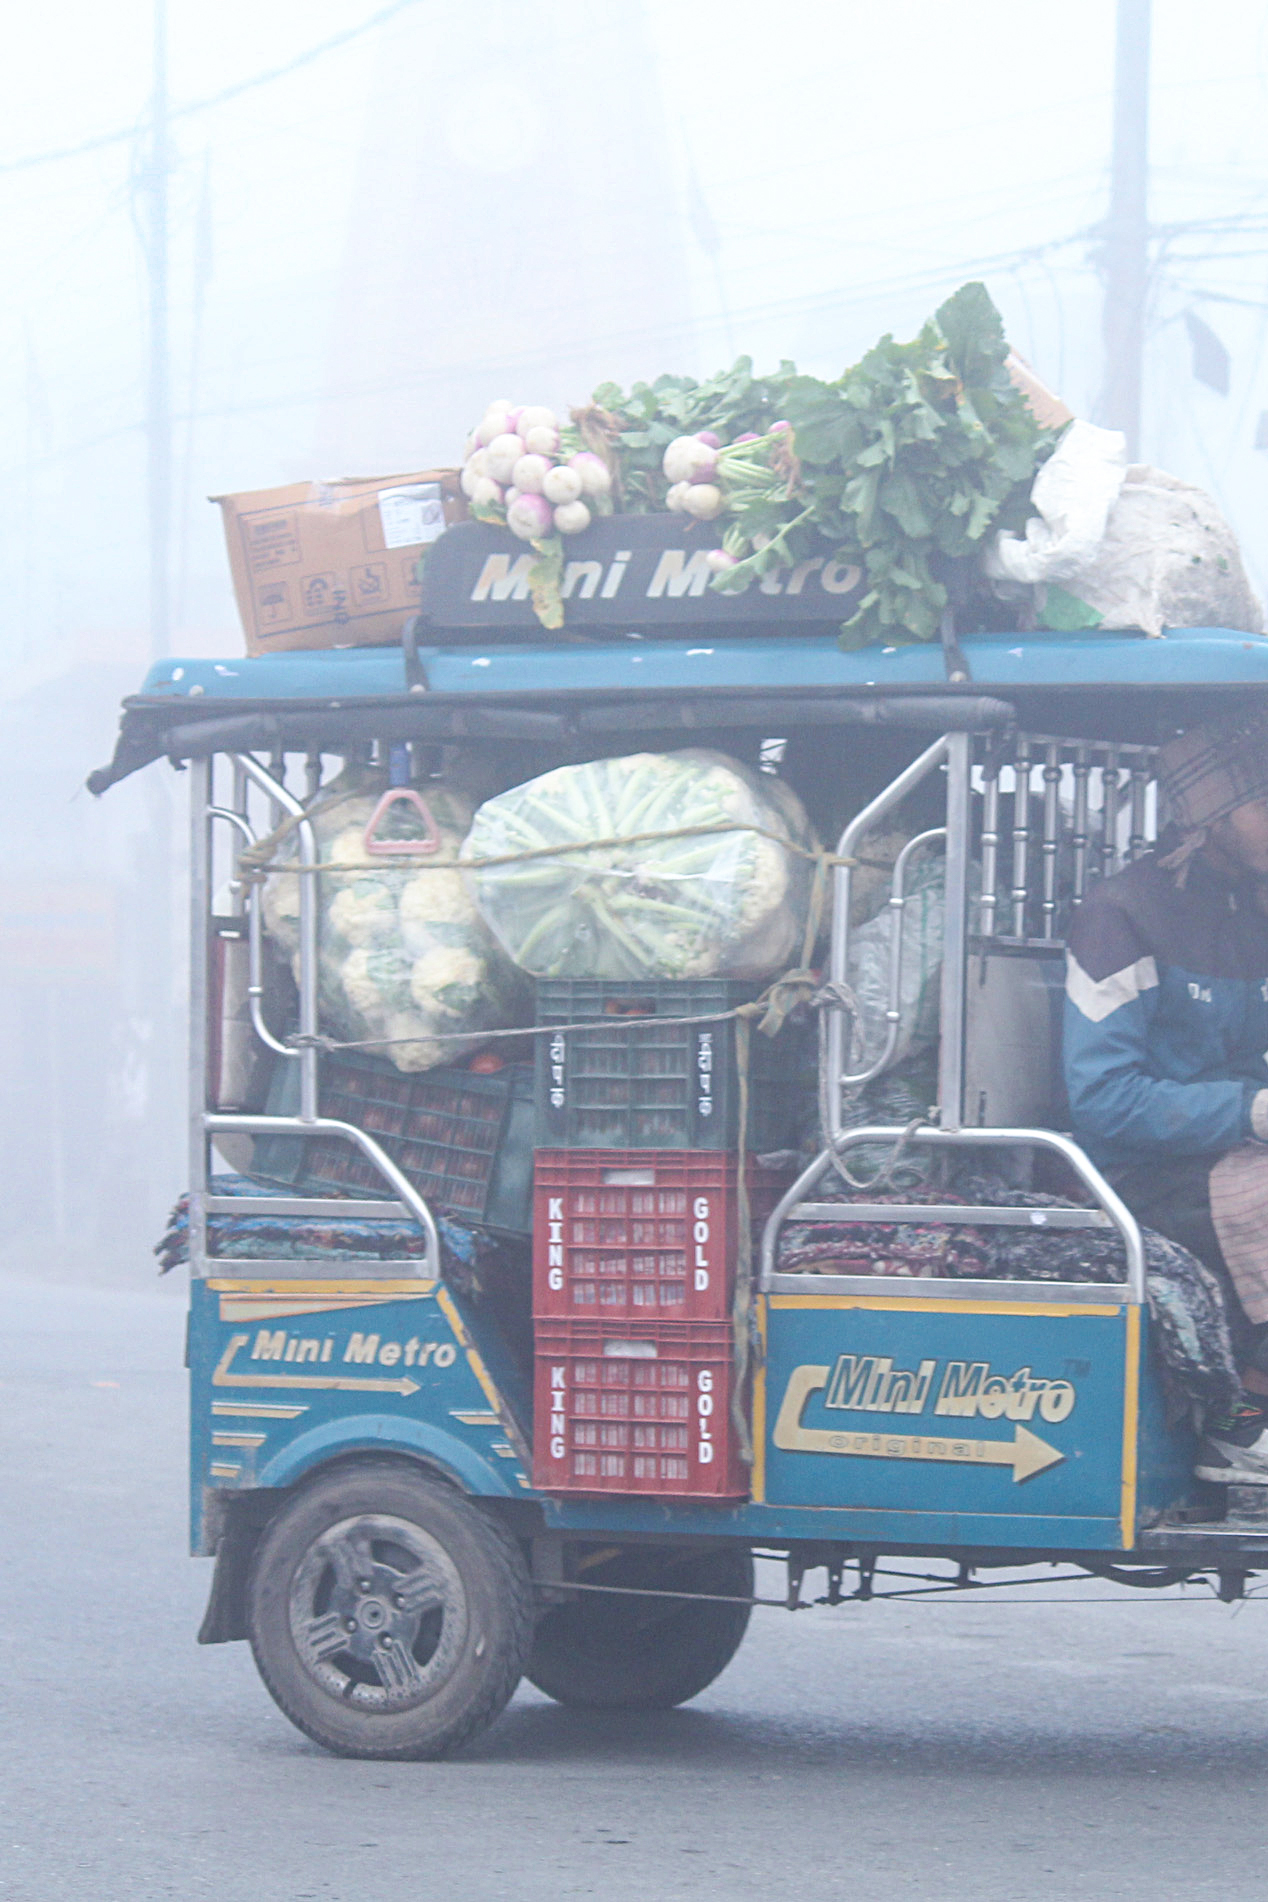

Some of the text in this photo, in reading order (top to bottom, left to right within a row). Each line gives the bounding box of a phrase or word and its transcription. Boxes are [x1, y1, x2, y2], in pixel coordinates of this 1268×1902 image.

[470, 549, 863, 602] Mni Mtro
[547, 1196, 563, 1291] KING
[692, 1196, 709, 1292] GOLD
[250, 1328, 457, 1369] Mini Metro
[825, 1353, 937, 1415] Mini
[934, 1360, 1076, 1423] Metro
[550, 1366, 566, 1459] KING
[697, 1369, 713, 1465] GOLD
[827, 1433, 987, 1457] original
